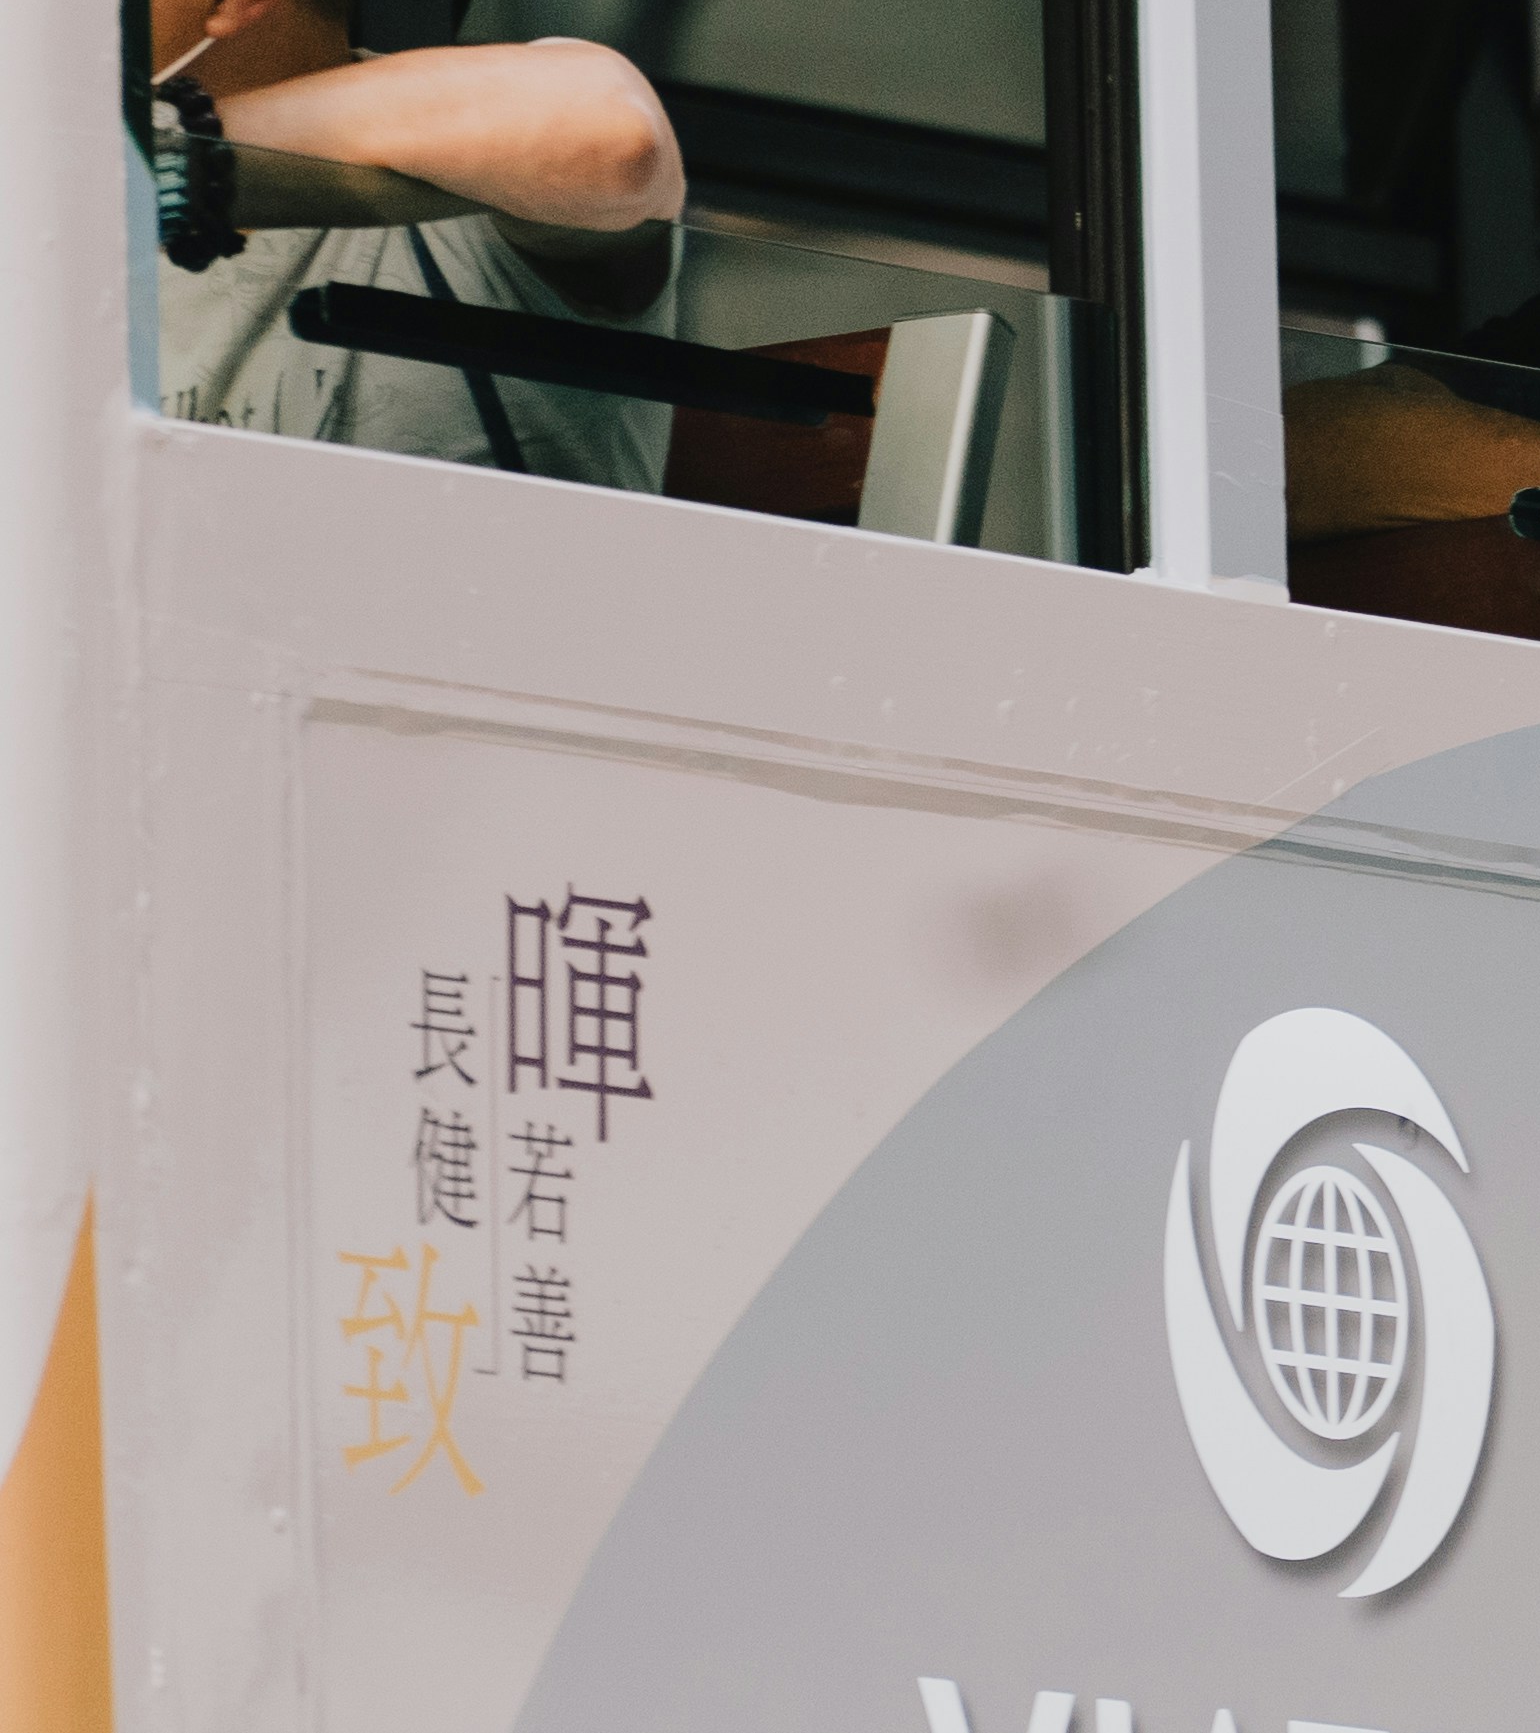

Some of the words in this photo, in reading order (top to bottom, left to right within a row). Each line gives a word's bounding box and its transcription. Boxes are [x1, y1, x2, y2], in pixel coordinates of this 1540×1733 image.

[504, 882, 654, 1143] 暉
[337, 1242, 486, 1498] 致
[506, 1120, 577, 1385] 若善
